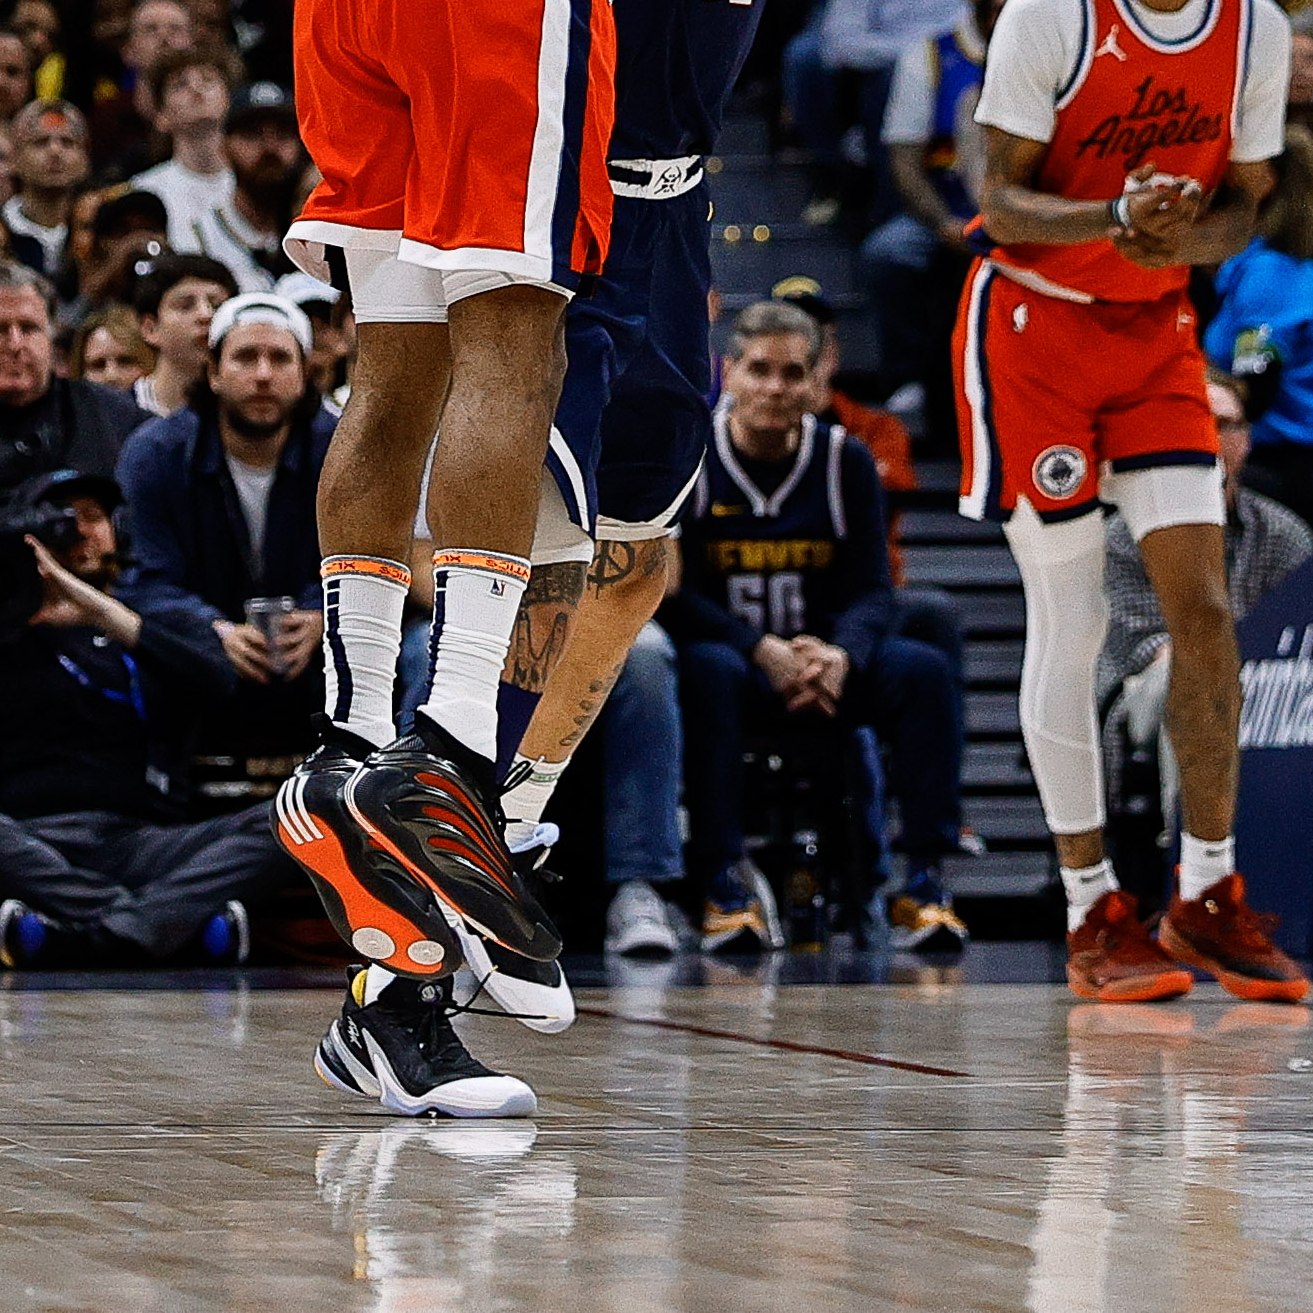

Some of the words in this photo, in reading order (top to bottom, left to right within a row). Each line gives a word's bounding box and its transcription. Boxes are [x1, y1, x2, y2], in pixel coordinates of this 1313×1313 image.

[1127, 74, 1188, 121] Los
[1075, 102, 1224, 172] Angeles
[726, 571, 807, 636] 50
